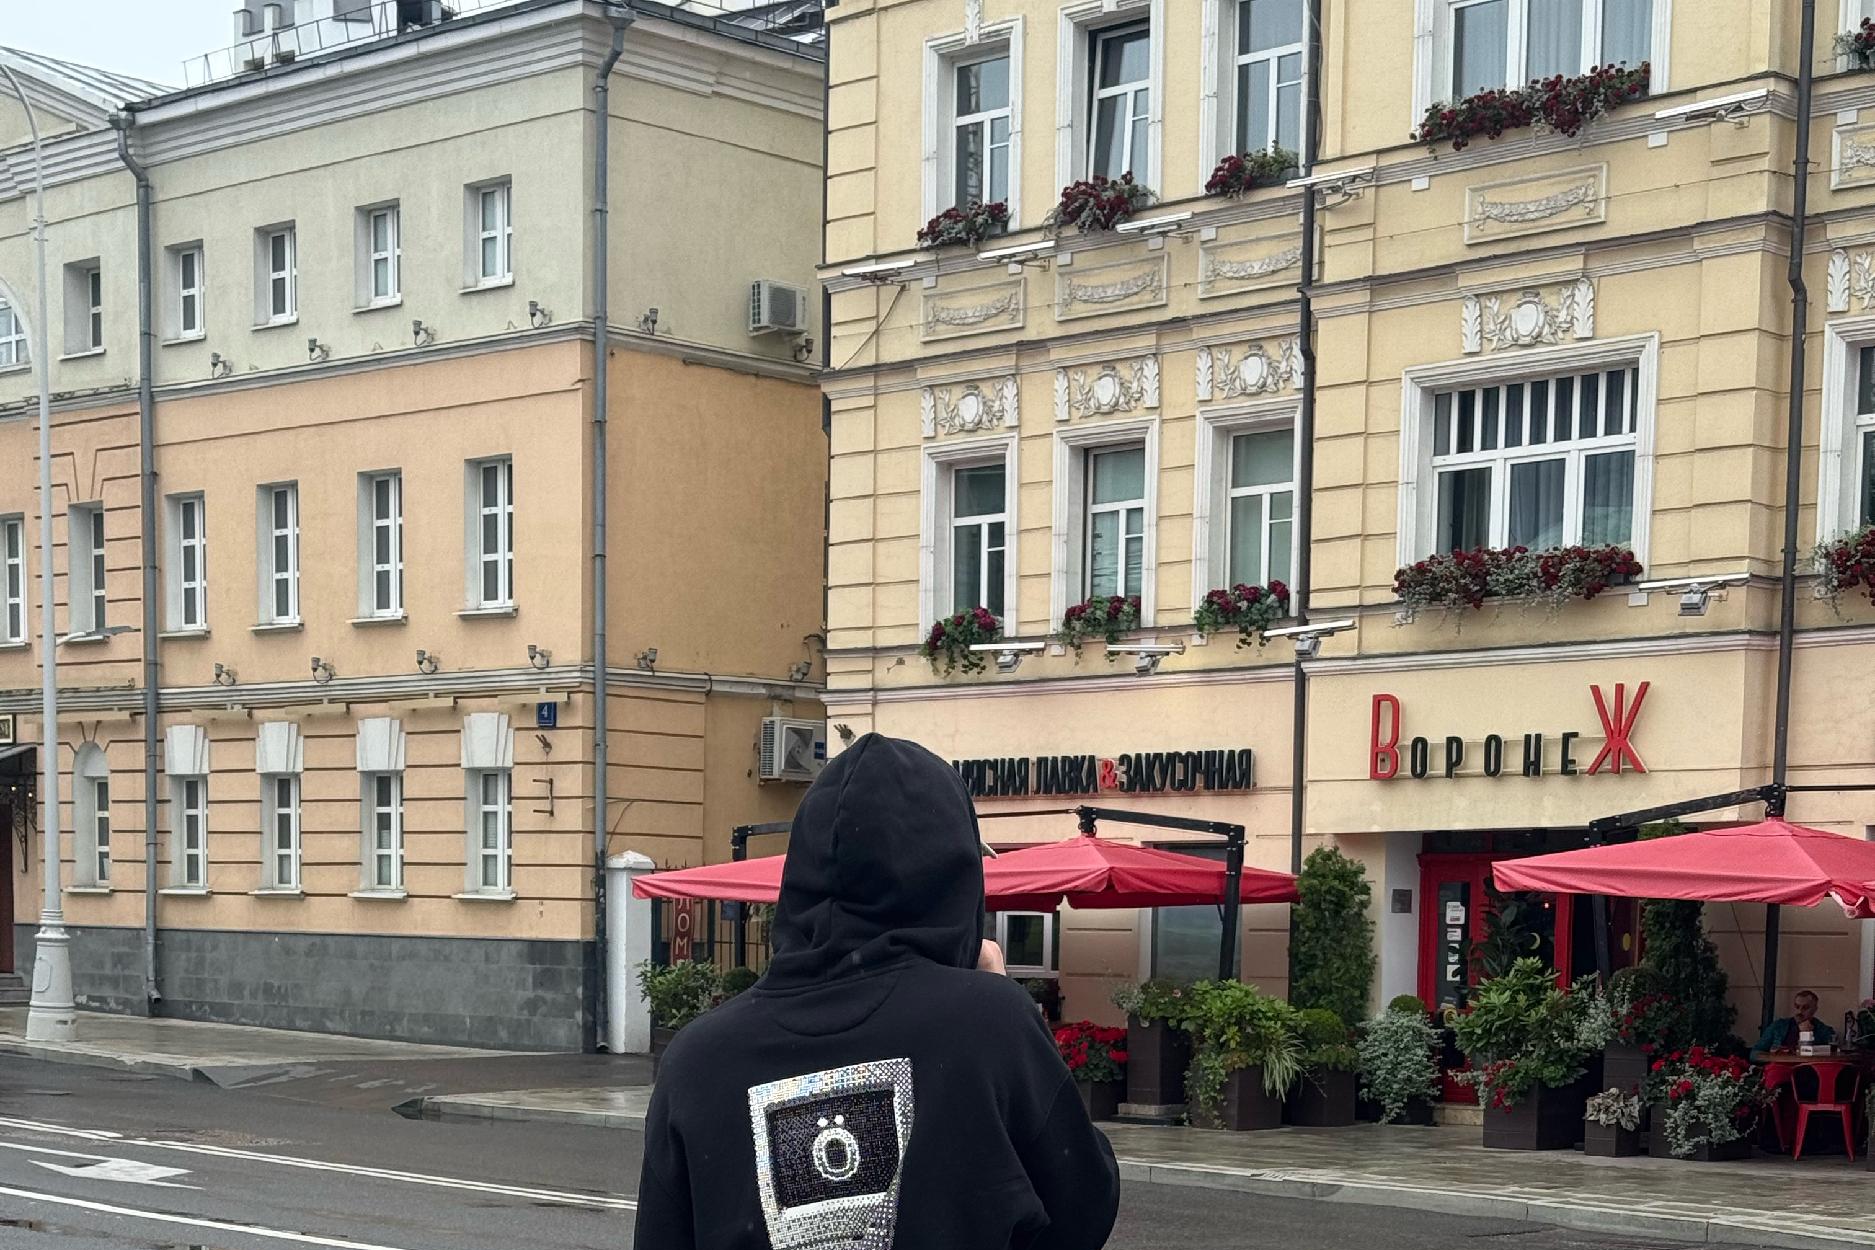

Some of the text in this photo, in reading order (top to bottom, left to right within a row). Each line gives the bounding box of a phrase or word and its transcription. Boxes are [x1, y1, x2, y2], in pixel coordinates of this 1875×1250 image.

[541, 704, 548, 718] 4
[1034, 754, 1098, 795] ЛАВКА
[1118, 748, 1252, 793] ЗАКУСОЧНАЯ
